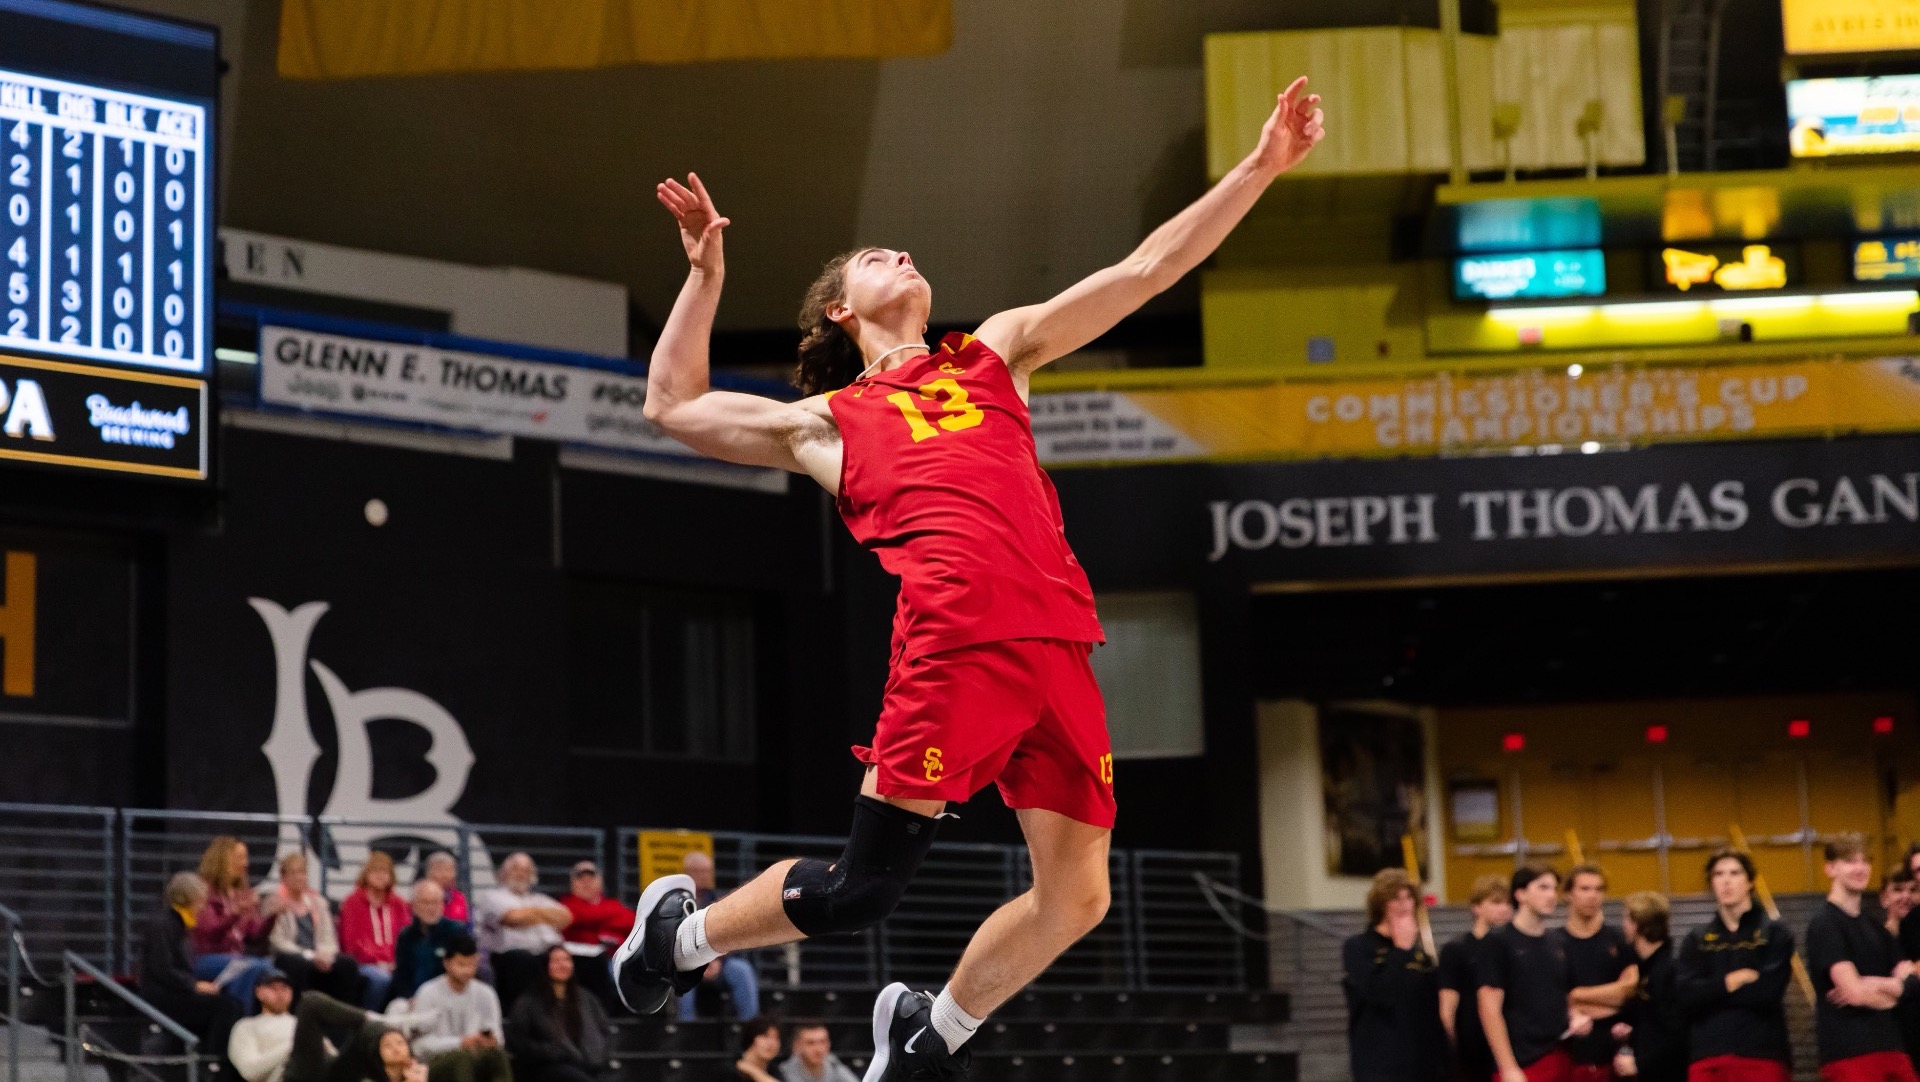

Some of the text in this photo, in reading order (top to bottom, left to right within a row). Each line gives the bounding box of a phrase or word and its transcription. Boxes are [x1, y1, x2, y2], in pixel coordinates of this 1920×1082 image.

[0, 82, 193, 139] KILL DIG BLK ACE
[10, 120, 185, 175] 4 2 1 0
[10, 155, 185, 211] 2 1 0 0
[9, 194, 183, 250] 0 1 0 1
[8, 236, 182, 291] 4 1 1 1
[9, 272, 184, 326] 5 3 0 0
[7, 308, 184, 359] 2 2 0 0
[274, 336, 388, 379] GLENN
[401, 353, 426, 383] E.
[439, 357, 570, 402] THOMAS
[886, 378, 985, 443] 13
[1305, 373, 1808, 424] COMMISSIONER'S CUP
[1375, 402, 1755, 447] CHAMPIONSHIPS
[1207, 493, 1440, 563] JOSEPH
[1458, 480, 1750, 541] THOMAS
